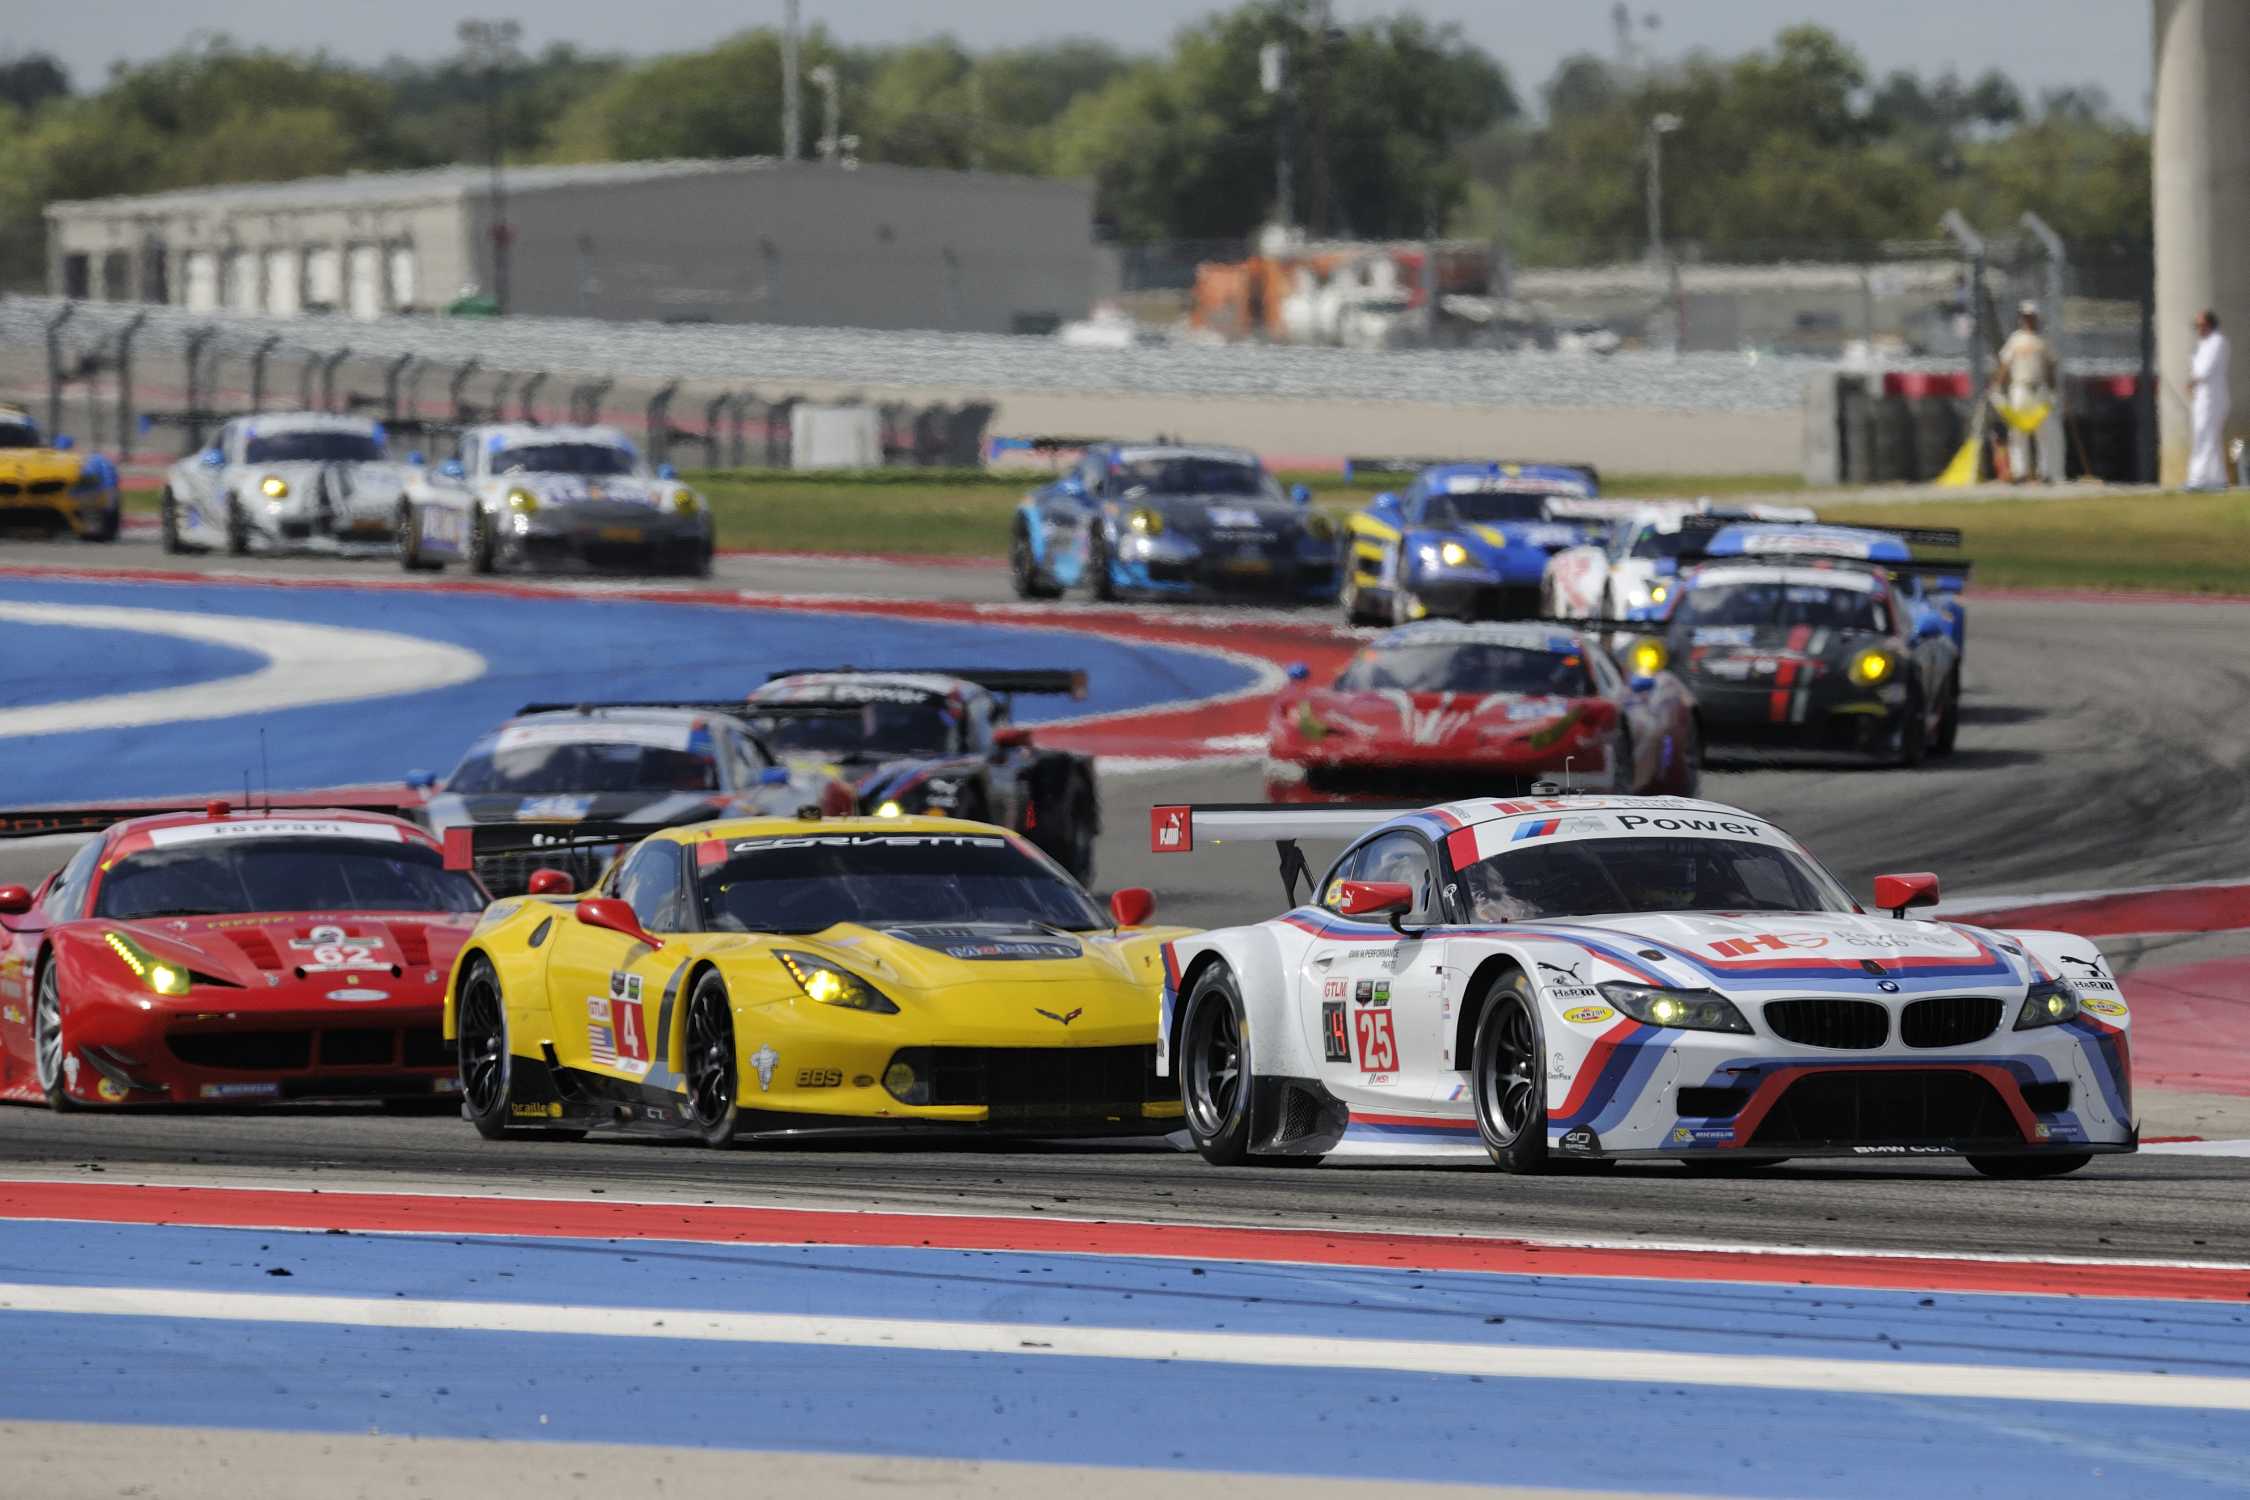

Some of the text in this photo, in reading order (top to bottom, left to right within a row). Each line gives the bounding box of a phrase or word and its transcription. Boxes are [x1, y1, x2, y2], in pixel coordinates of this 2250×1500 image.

[1616, 815, 1761, 837] Power
[734, 836, 1005, 852] CORVETTE
[313, 948, 375, 965] 62
[1324, 981, 1348, 998] GTLM
[624, 1002, 639, 1058] 4
[1361, 1012, 1394, 1070] 25
[796, 1068, 844, 1089] BBS
[1852, 1145, 1906, 1154] BMW
